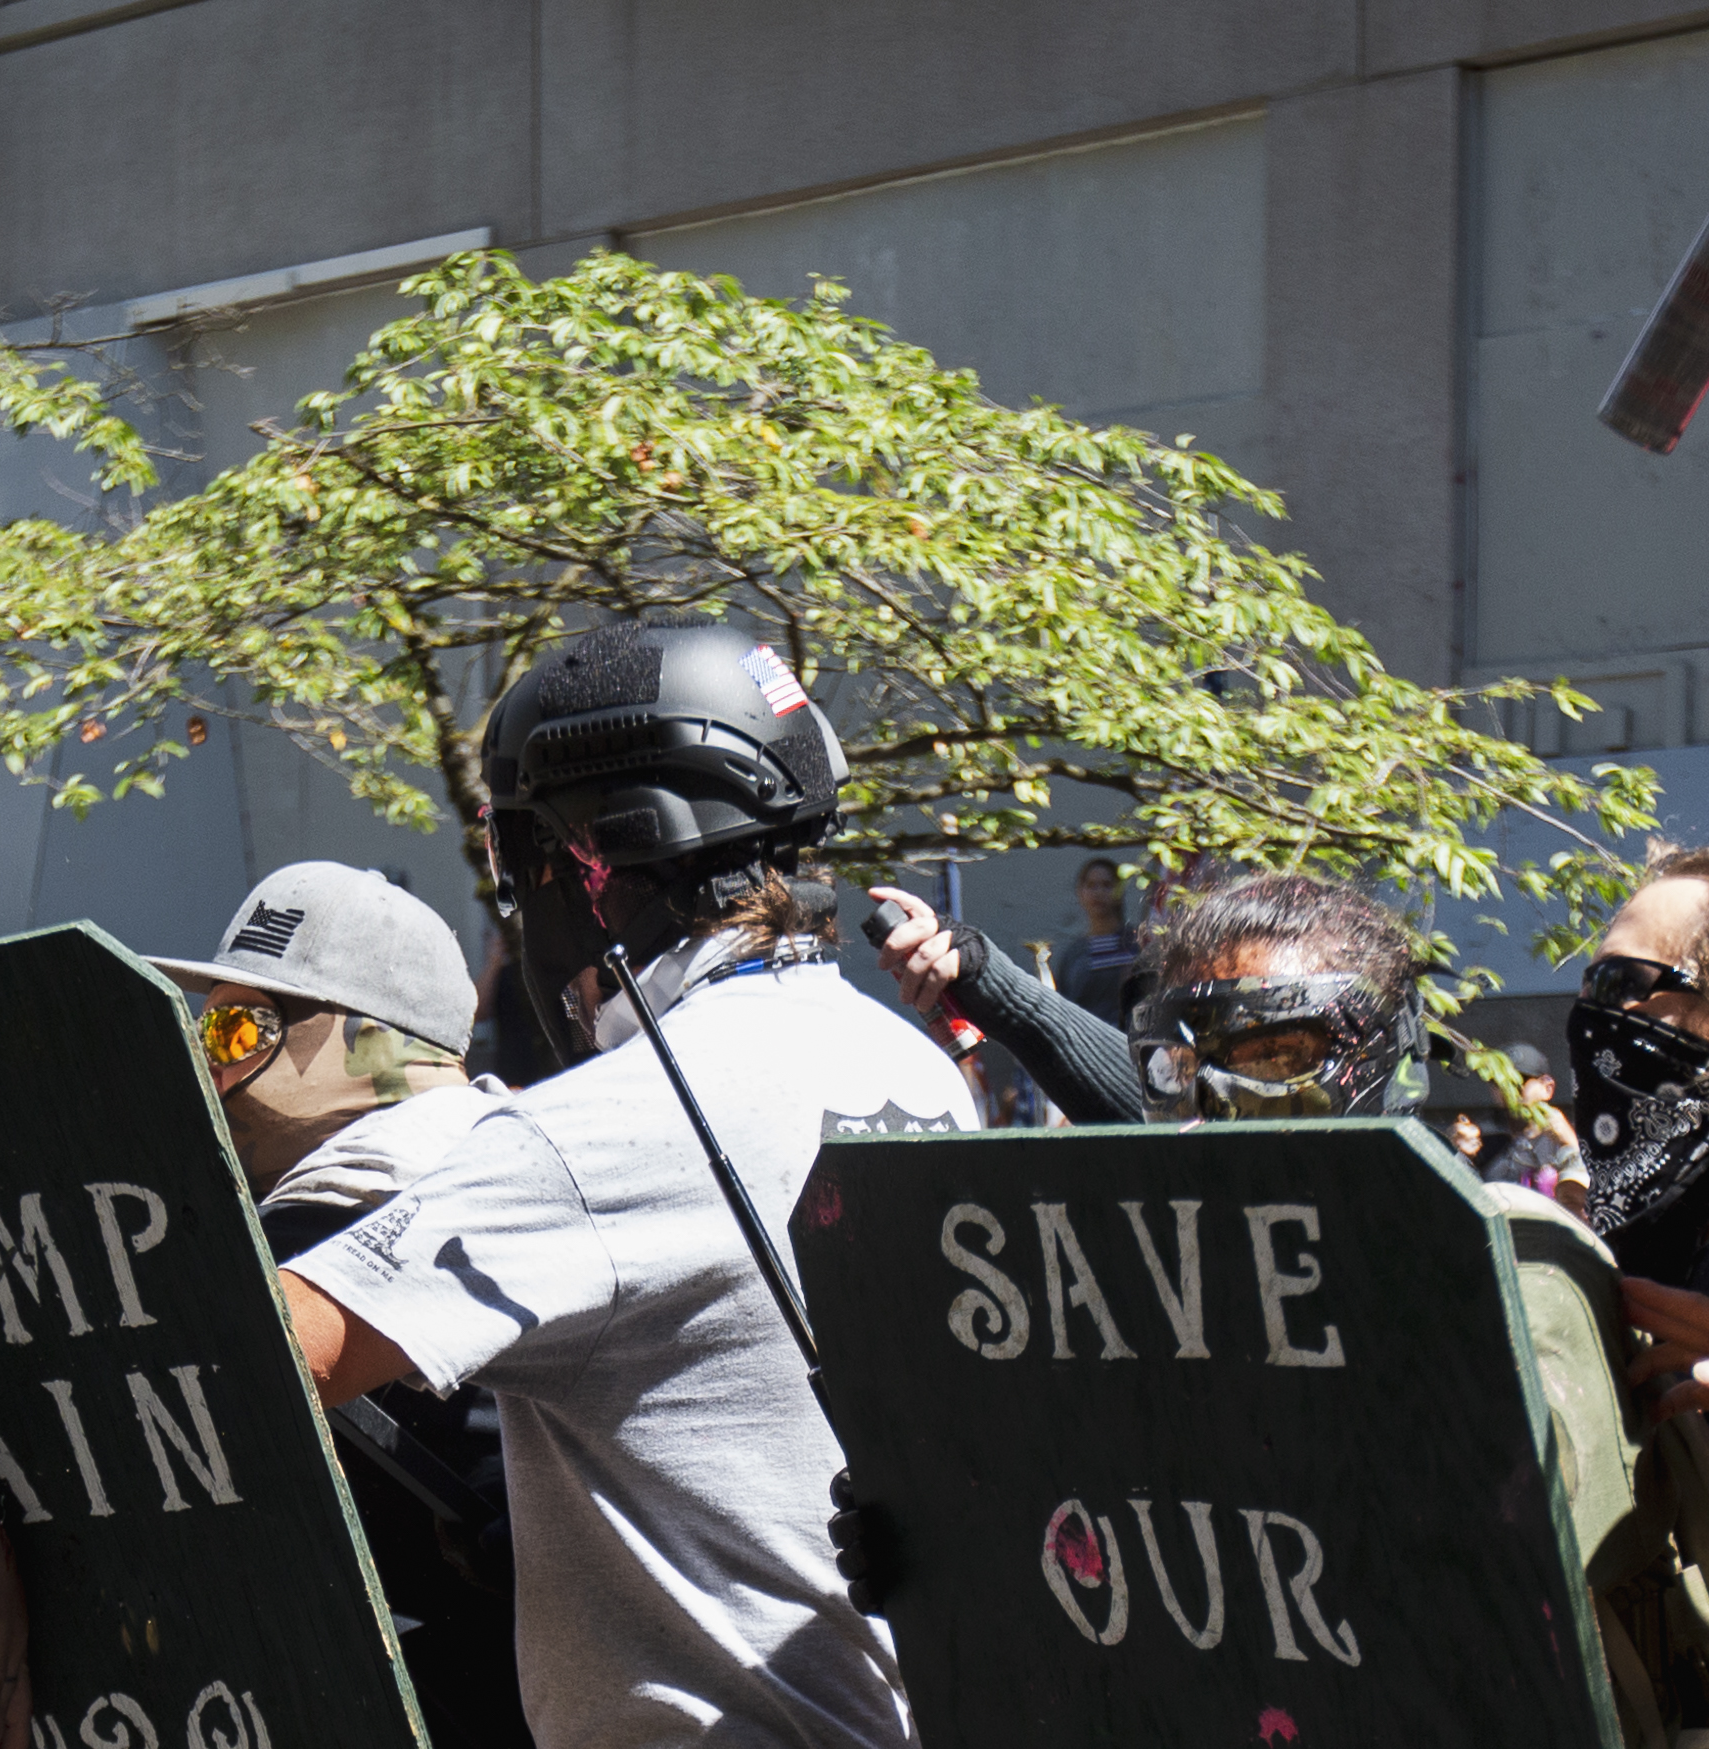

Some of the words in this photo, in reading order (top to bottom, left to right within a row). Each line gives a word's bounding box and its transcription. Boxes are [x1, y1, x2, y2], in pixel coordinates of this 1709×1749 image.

[366, 1260, 380, 1272] ON
[381, 1270, 395, 1283] ME
[941, 1200, 1347, 1368] SAVE
[1041, 1498, 1362, 1668] OUR
